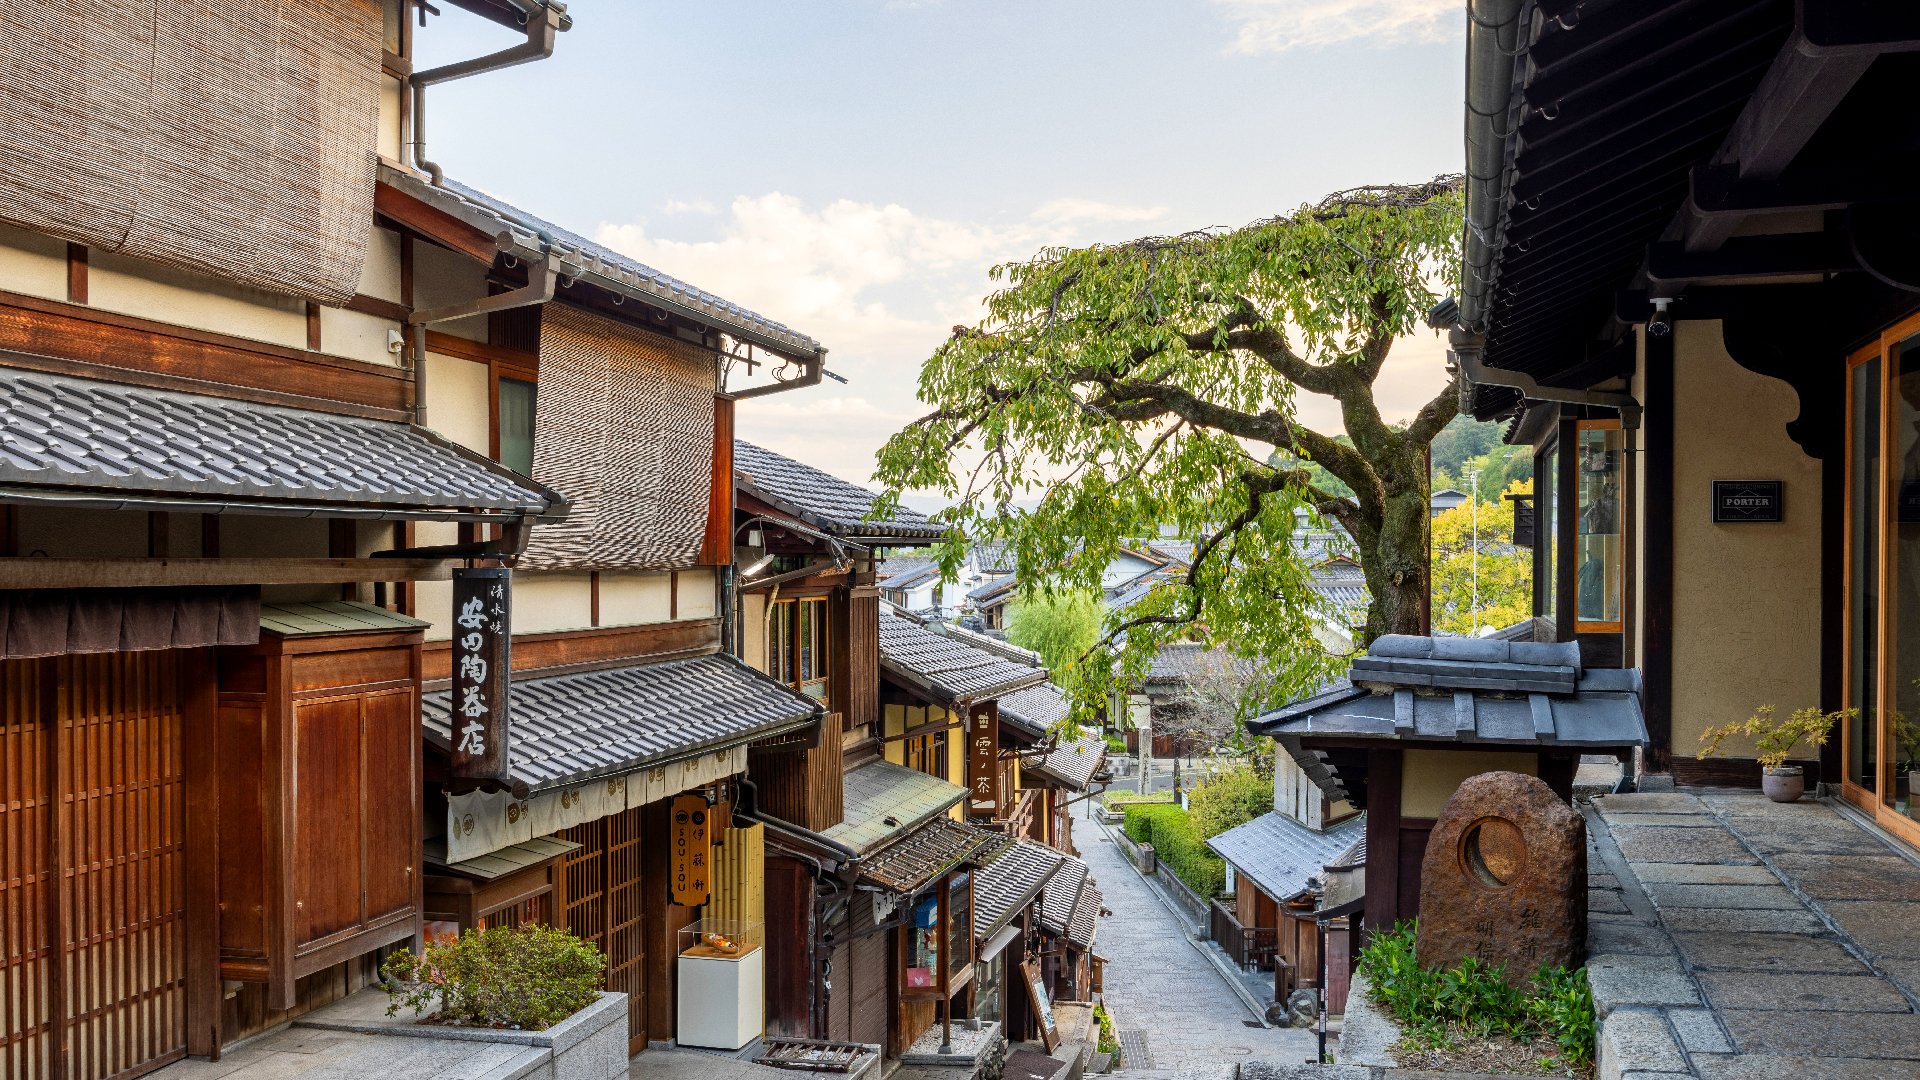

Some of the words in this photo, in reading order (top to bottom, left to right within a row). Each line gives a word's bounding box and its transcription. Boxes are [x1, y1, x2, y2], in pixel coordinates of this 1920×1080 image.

[1725, 498, 1769, 506] PORTER
[457, 596, 489, 756] 安田陶器店
